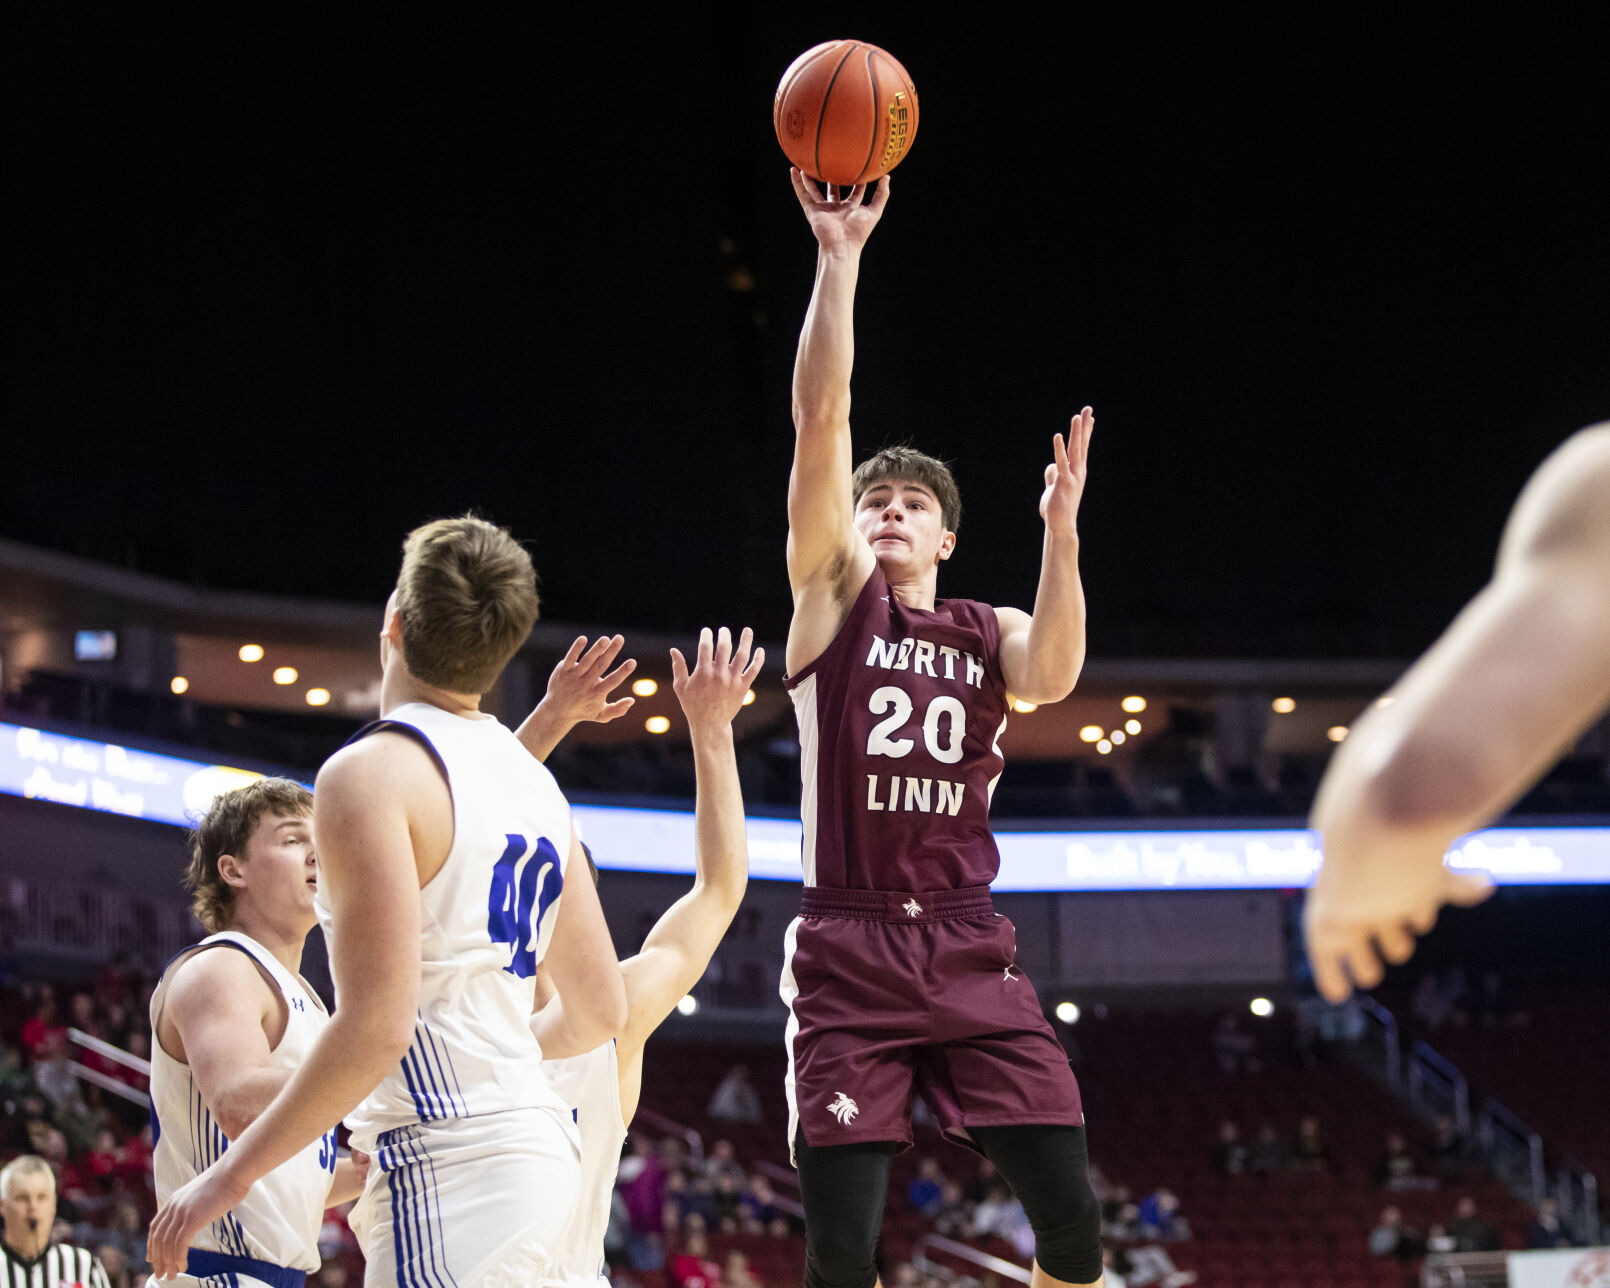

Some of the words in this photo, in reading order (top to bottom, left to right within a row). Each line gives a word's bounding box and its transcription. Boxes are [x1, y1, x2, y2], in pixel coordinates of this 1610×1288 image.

[865, 635, 985, 690] NORTH
[867, 686, 967, 764] 20
[867, 774, 965, 816] LINN
[488, 834, 563, 979] 40
